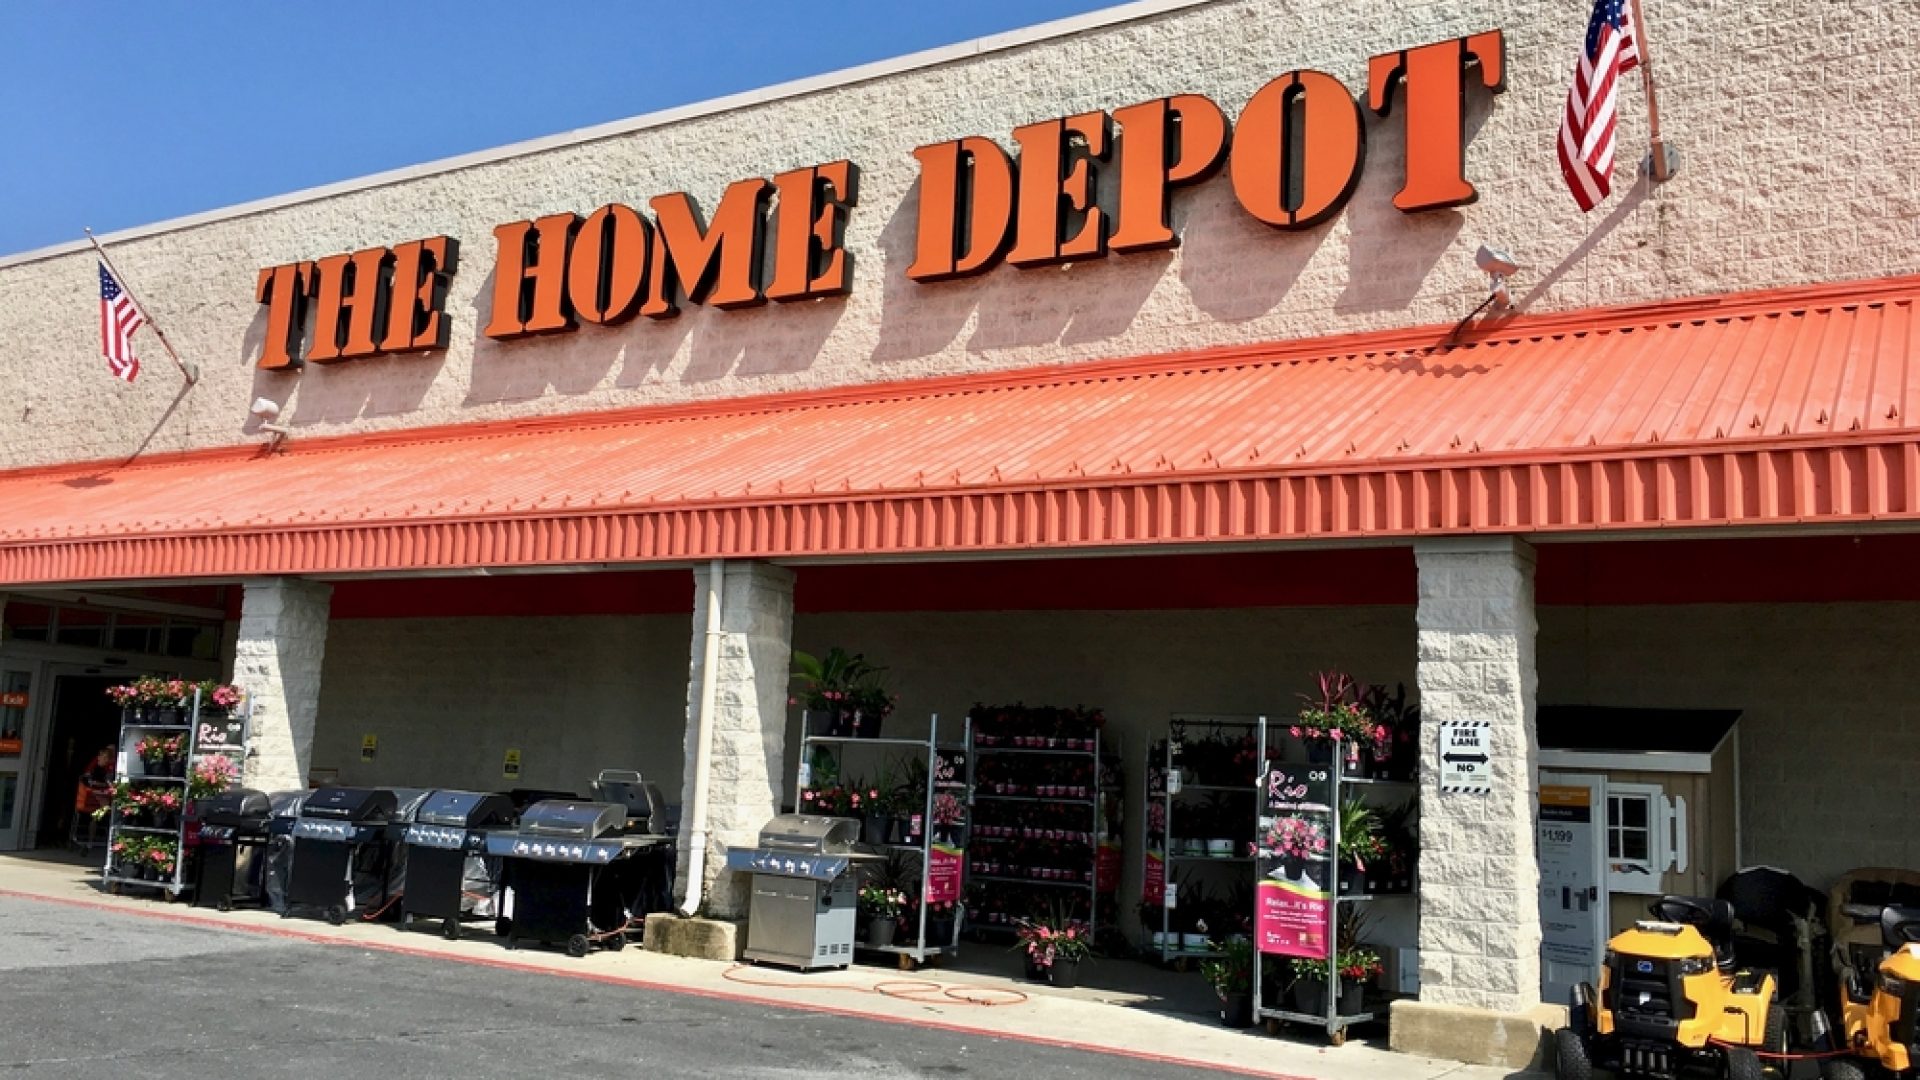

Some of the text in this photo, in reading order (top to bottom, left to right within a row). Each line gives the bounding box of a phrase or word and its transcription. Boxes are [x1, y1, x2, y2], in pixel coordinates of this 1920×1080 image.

[256, 29, 1504, 371] THE HOME DEPOT
[1453, 728, 1478, 738] FIRE
[1451, 738, 1480, 747] LANE
[1456, 763, 1476, 773] NO
[1268, 769, 1308, 800] Rio
